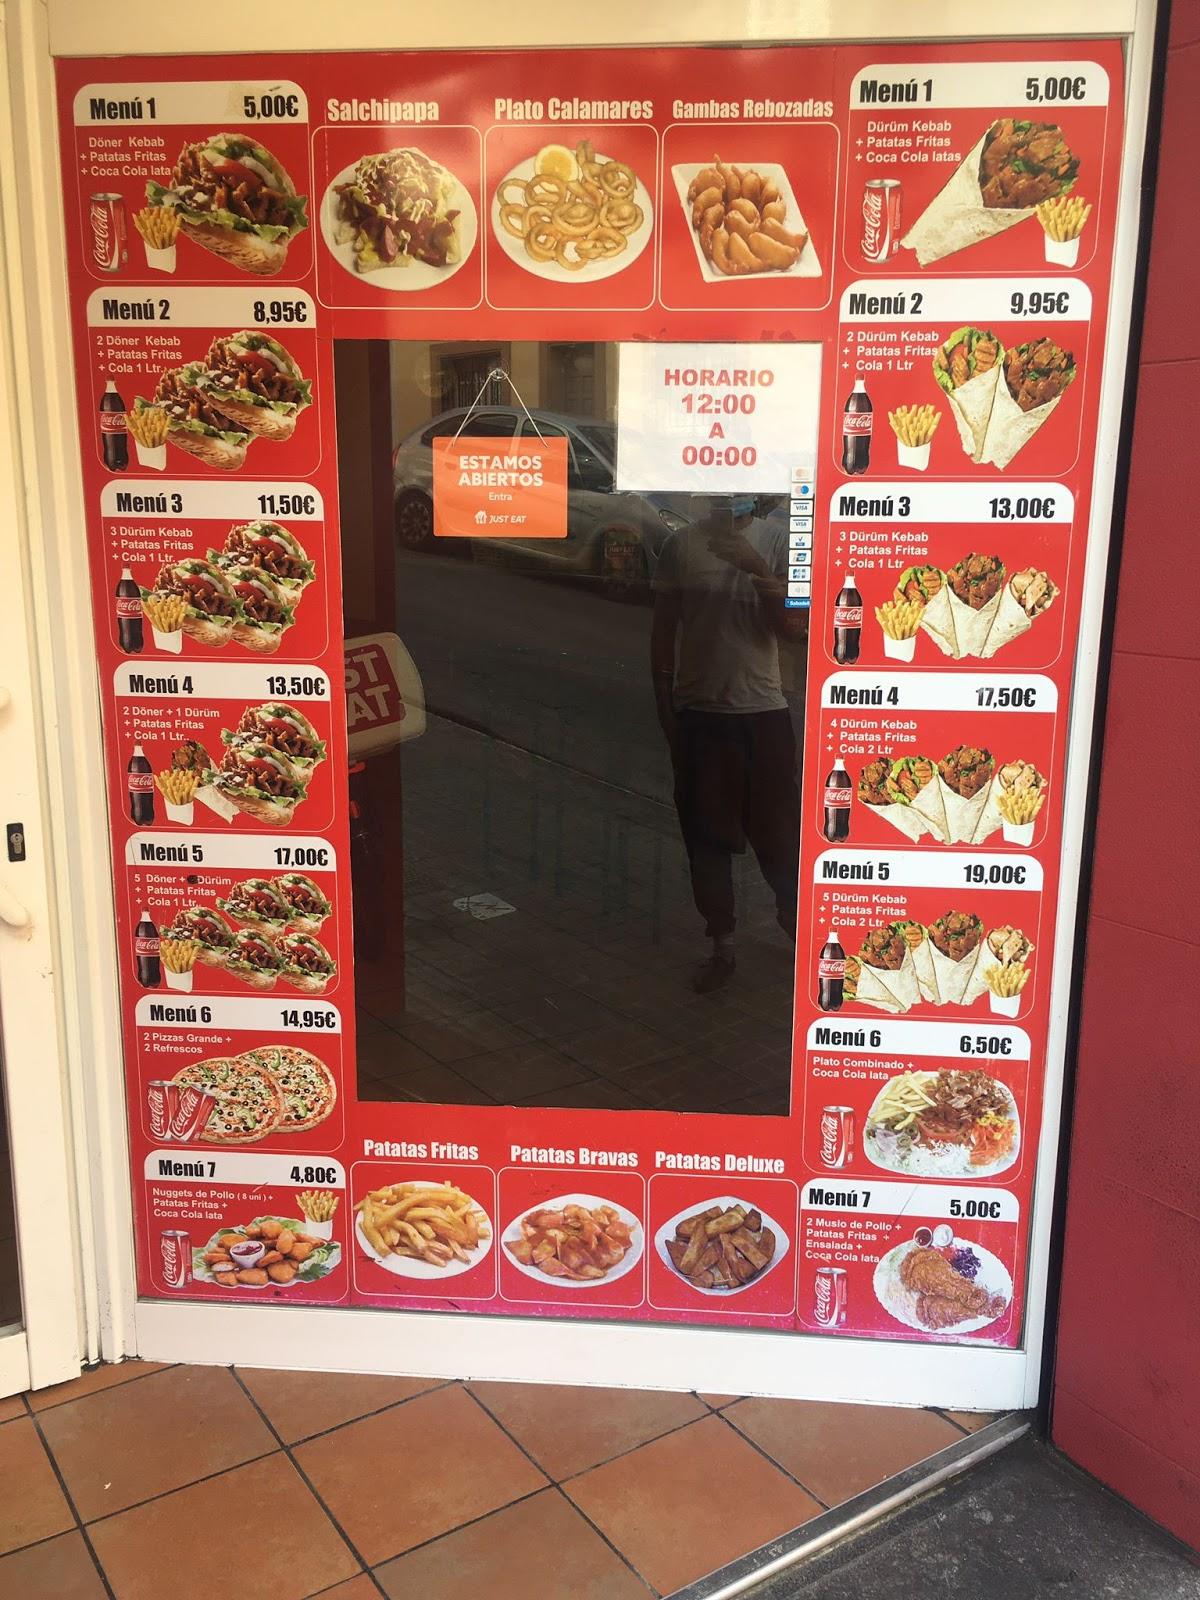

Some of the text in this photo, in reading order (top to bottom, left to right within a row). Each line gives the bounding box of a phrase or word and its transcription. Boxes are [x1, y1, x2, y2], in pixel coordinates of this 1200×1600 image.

[860, 79, 933, 103] Menú 1
[1026, 77, 1086, 102] 5,00€
[90, 97, 155, 119] Menú 1
[244, 95, 298, 119] 5,00€
[328, 98, 439, 123] Salchipapa
[495, 98, 653, 120] Plato Calamares
[673, 99, 833, 119] Gambas Rebozadas
[867, 120, 952, 132] Dürüm Kebab
[89, 137, 164, 147] Döner Kebab
[867, 136, 951, 148] Patatas Fritas
[90, 151, 166, 161] Patatas Fritas
[866, 151, 961, 162] Coca Cola latas
[91, 166, 171, 176] Coca Cola lata
[103, 299, 170, 320] Menú 2
[849, 292, 923, 315] Menú 2
[1010, 292, 1069, 316] 9,95€
[254, 301, 307, 324] 8,95€
[106, 336, 181, 346] Döner Kebab
[857, 331, 939, 342] Dürüm Kebab
[108, 350, 182, 359] Patatas Fritas
[857, 346, 938, 356] Patatas Fritas
[109, 363, 133, 373] Cola
[856, 360, 914, 370] Cola Ltr
[664, 369, 774, 386] HORARIO
[682, 394, 756, 414] 12:00
[709, 423, 724, 438] A
[682, 446, 757, 466] 00:00
[459, 456, 542, 469] ESTAMOS
[458, 473, 543, 486] ABIERTOS
[116, 492, 182, 512] Menú 3
[489, 492, 512, 500] Entra
[258, 495, 315, 515] 11,50€
[839, 496, 910, 516] Menú 3
[989, 498, 1055, 520] 13,00€
[489, 516, 509, 524] JUST
[120, 527, 193, 537] Dürüm Kebab
[850, 531, 928, 542] Dürüm Kebab
[121, 540, 194, 550] Patatas Fritas
[849, 545, 928, 555] Patatas Fritas
[122, 553, 146, 562] Cola
[848, 559, 904, 568] Cola Ltr
[129, 675, 193, 694] Menú 4
[267, 677, 325, 697] 13,50€
[830, 686, 899, 705] Menú 4
[976, 688, 1036, 708] 17,50€
[132, 706, 220, 717] Döner Dürüm
[134, 720, 204, 729] Patatas Fritas
[840, 719, 917, 729] Dürüm Kebab
[134, 731, 158, 740] Cola
[840, 732, 916, 742] Patatas Fritas
[840, 744, 893, 754] Cola Ltr
[140, 843, 203, 862] Menú 5
[274, 848, 328, 866] 17,00€
[823, 861, 889, 880] Menú 5
[964, 865, 1026, 884] 19,00€
[147, 875, 231, 885] Döner Dürüm
[147, 886, 216, 896] Patatas Fritas
[148, 897, 170, 906] Cola
[833, 893, 907, 903] Dürüm Kebab
[832, 905, 906, 915] Patatas Fritas
[832, 917, 884, 927] Cola Ltr
[150, 1005, 211, 1023] Menú 6
[281, 1011, 335, 1029] 14,95€
[152, 1033, 223, 1043] Pizzas Grande
[816, 1028, 881, 1047] Menú 6
[153, 1044, 203, 1053] Refrescos
[960, 1036, 1012, 1055] 6,50€
[813, 1057, 904, 1069] Plato Combinado
[813, 1069, 888, 1080] Coca Cola lata
[364, 1140, 479, 1160] Patatas Fritas
[511, 1145, 638, 1167] Patatas Bravas
[655, 1151, 784, 1173] Patatas Deluxe
[159, 1160, 216, 1177] Menú 7
[290, 1167, 336, 1184] 4,80€
[153, 1188, 234, 1199] Nuggets de Pollo
[809, 1189, 870, 1207] Menú 7
[153, 1199, 219, 1209] Patatas Fritas
[950, 1200, 1001, 1218] 5,00€
[154, 1209, 223, 1219] Coca Cola lata
[816, 1219, 892, 1231] Muslo de Pollo
[807, 1229, 877, 1241] Patatas Fritas
[806, 1240, 854, 1250] Ensalada
[806, 1251, 879, 1263] Coca Cola lata
